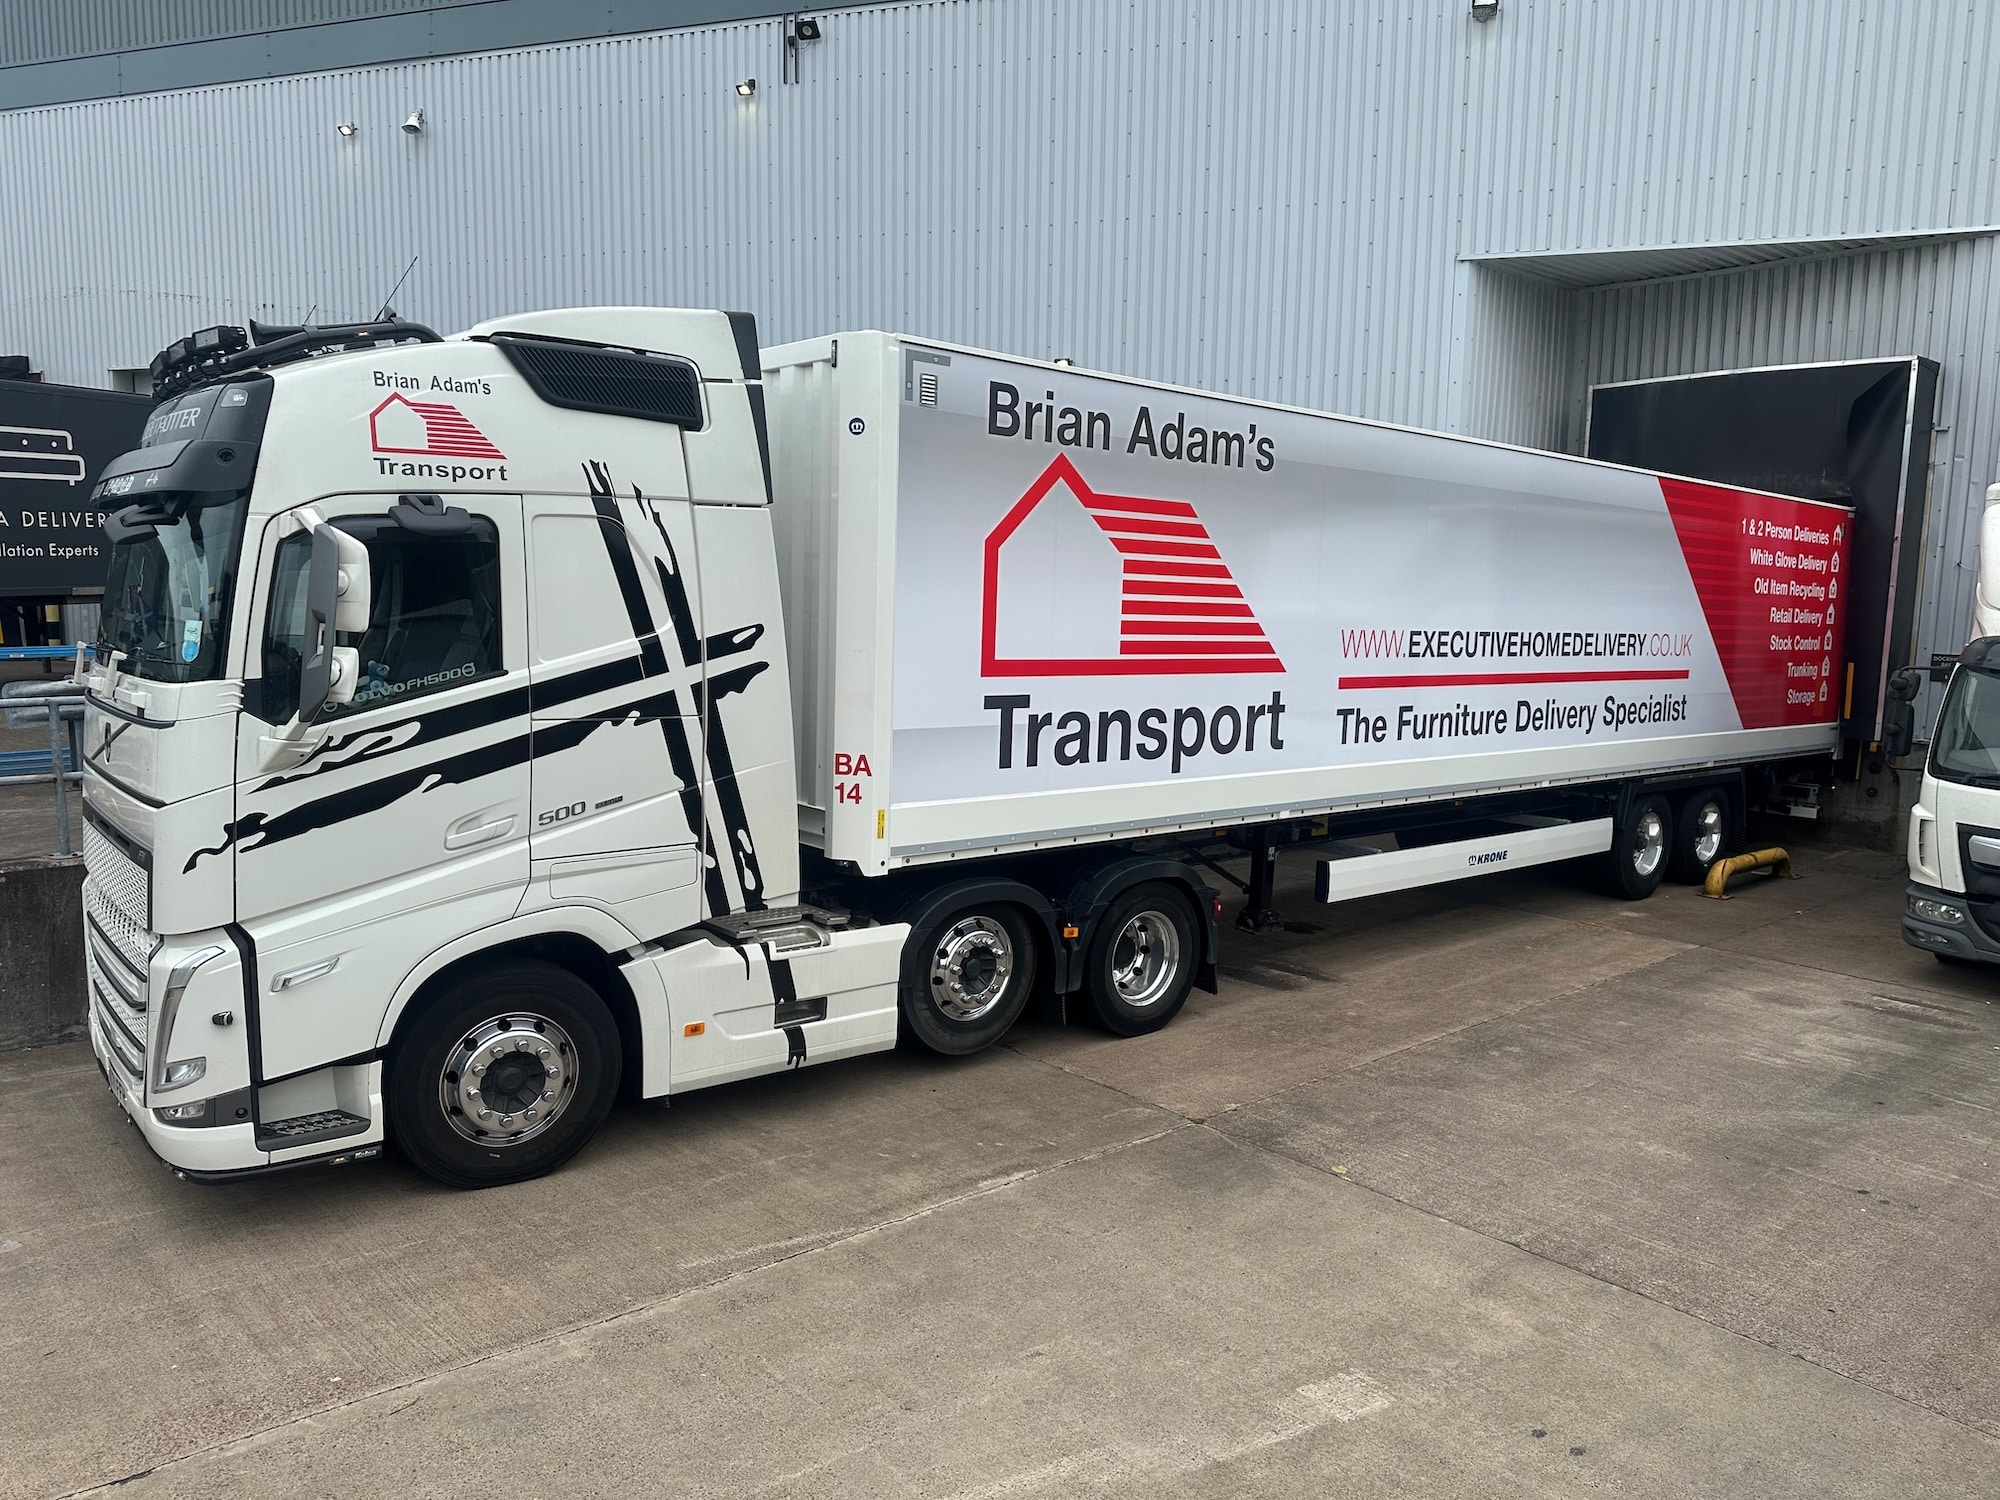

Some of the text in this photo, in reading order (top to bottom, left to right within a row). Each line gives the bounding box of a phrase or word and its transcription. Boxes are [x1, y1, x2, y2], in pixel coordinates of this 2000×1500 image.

[373, 371, 491, 395] Brian Adam's
[988, 380, 1275, 472] Brian Adam’s
[373, 457, 508, 482] Transport
[21, 510, 113, 528] DELIVER
[1742, 518, 1830, 545] 1 & 2 Person Deliveries
[48, 542, 100, 559] Experts
[1750, 548, 1828, 575] White Glove Delivery
[1754, 577, 1825, 601] Old Item Recycling
[1769, 607, 1823, 628] Retail Delivery
[1341, 629, 1693, 659] WWW.EXECUTIVEHOMEDELIVERY.CO.UK
[1769, 634, 1821, 651] Stock Control
[406, 667, 462, 691] FH500
[1786, 662, 1819, 681] Trunking
[1786, 688, 1816, 706] Storage
[1336, 693, 1687, 745] The Furniture Delivery Specialist
[983, 691, 1286, 774] Transport
[834, 753, 873, 777] BA
[834, 782, 863, 805] 14
[538, 801, 586, 826] 500
[1477, 850, 1508, 865] KRONE
